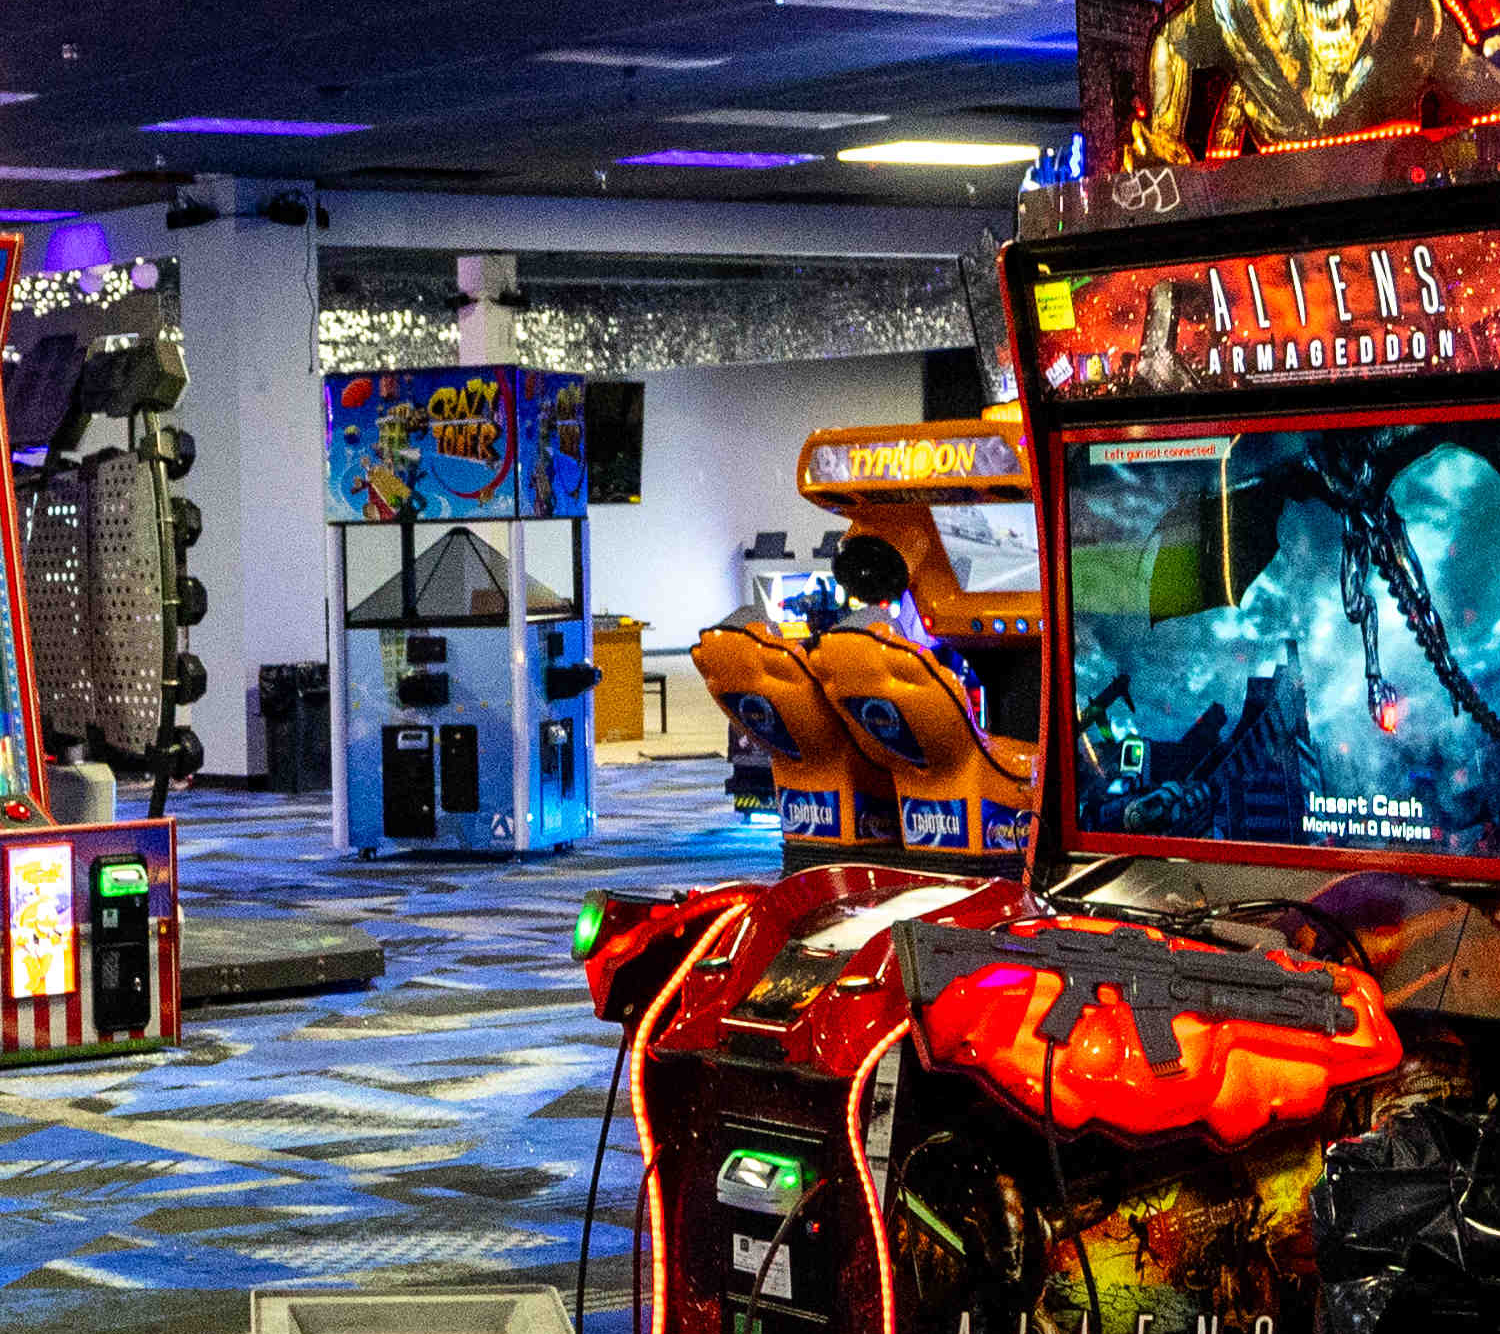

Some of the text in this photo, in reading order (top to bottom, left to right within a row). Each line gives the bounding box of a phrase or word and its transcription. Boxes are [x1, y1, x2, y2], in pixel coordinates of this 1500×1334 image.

[1209, 245, 1440, 331] ALIENS
[1209, 329, 1454, 375] ARMAGEDDON
[428, 378, 498, 420] CRAZY
[432, 424, 498, 461] TOWER
[1309, 790, 1423, 818] Insert Cash
[1302, 816, 1345, 837] Money
[1380, 820, 1432, 841] Swipes
